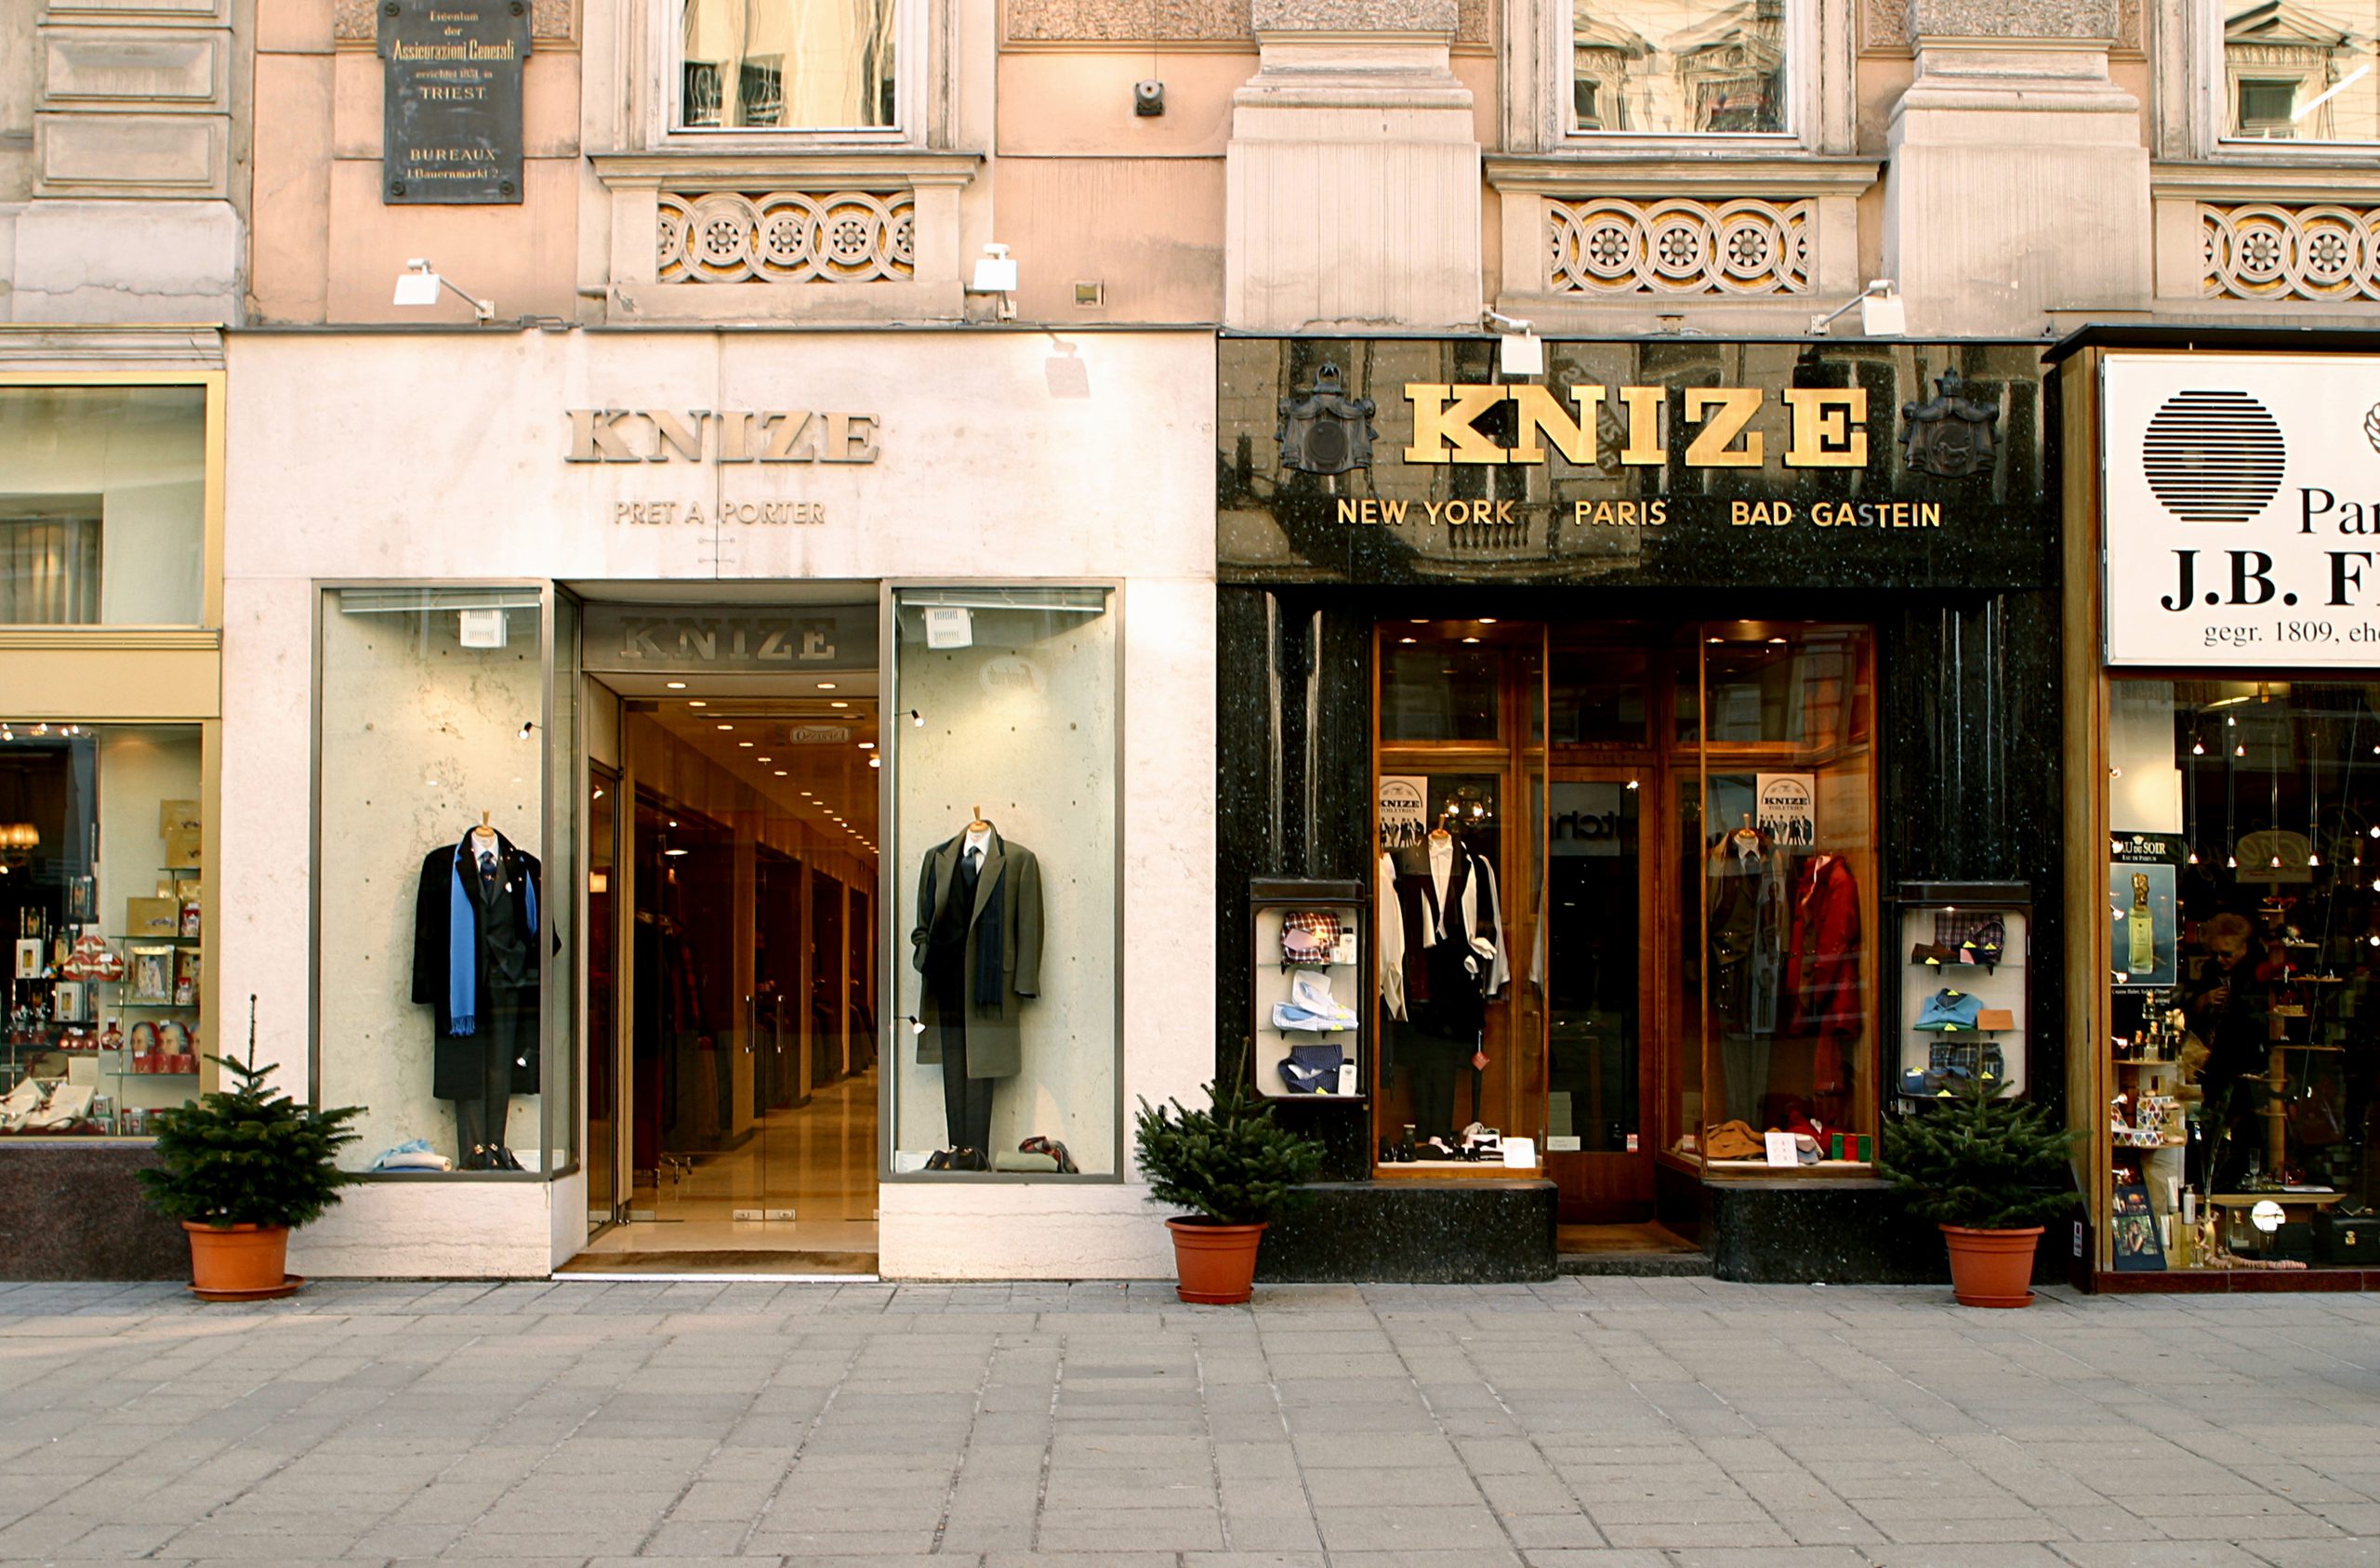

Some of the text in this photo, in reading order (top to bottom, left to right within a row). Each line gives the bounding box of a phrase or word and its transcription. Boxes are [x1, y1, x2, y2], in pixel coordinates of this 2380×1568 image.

[444, 25, 463, 36] der
[392, 39, 514, 60] Assicurazioni Generali
[410, 149, 496, 162] BUREAUX
[564, 409, 880, 464] KNIZE
[1403, 384, 1868, 468] KNIZE
[614, 501, 826, 525] PRET A PORTER
[1337, 499, 1941, 528] NEW YORK PARIS BAD GASTEIN
[2323, 551, 2380, 607] F
[619, 615, 837, 661] KNIZE
[2203, 621, 2380, 648] gegr. 1809, eh
[1764, 797, 1808, 806] KNIZE
[2143, 841, 2167, 855] SOIR
